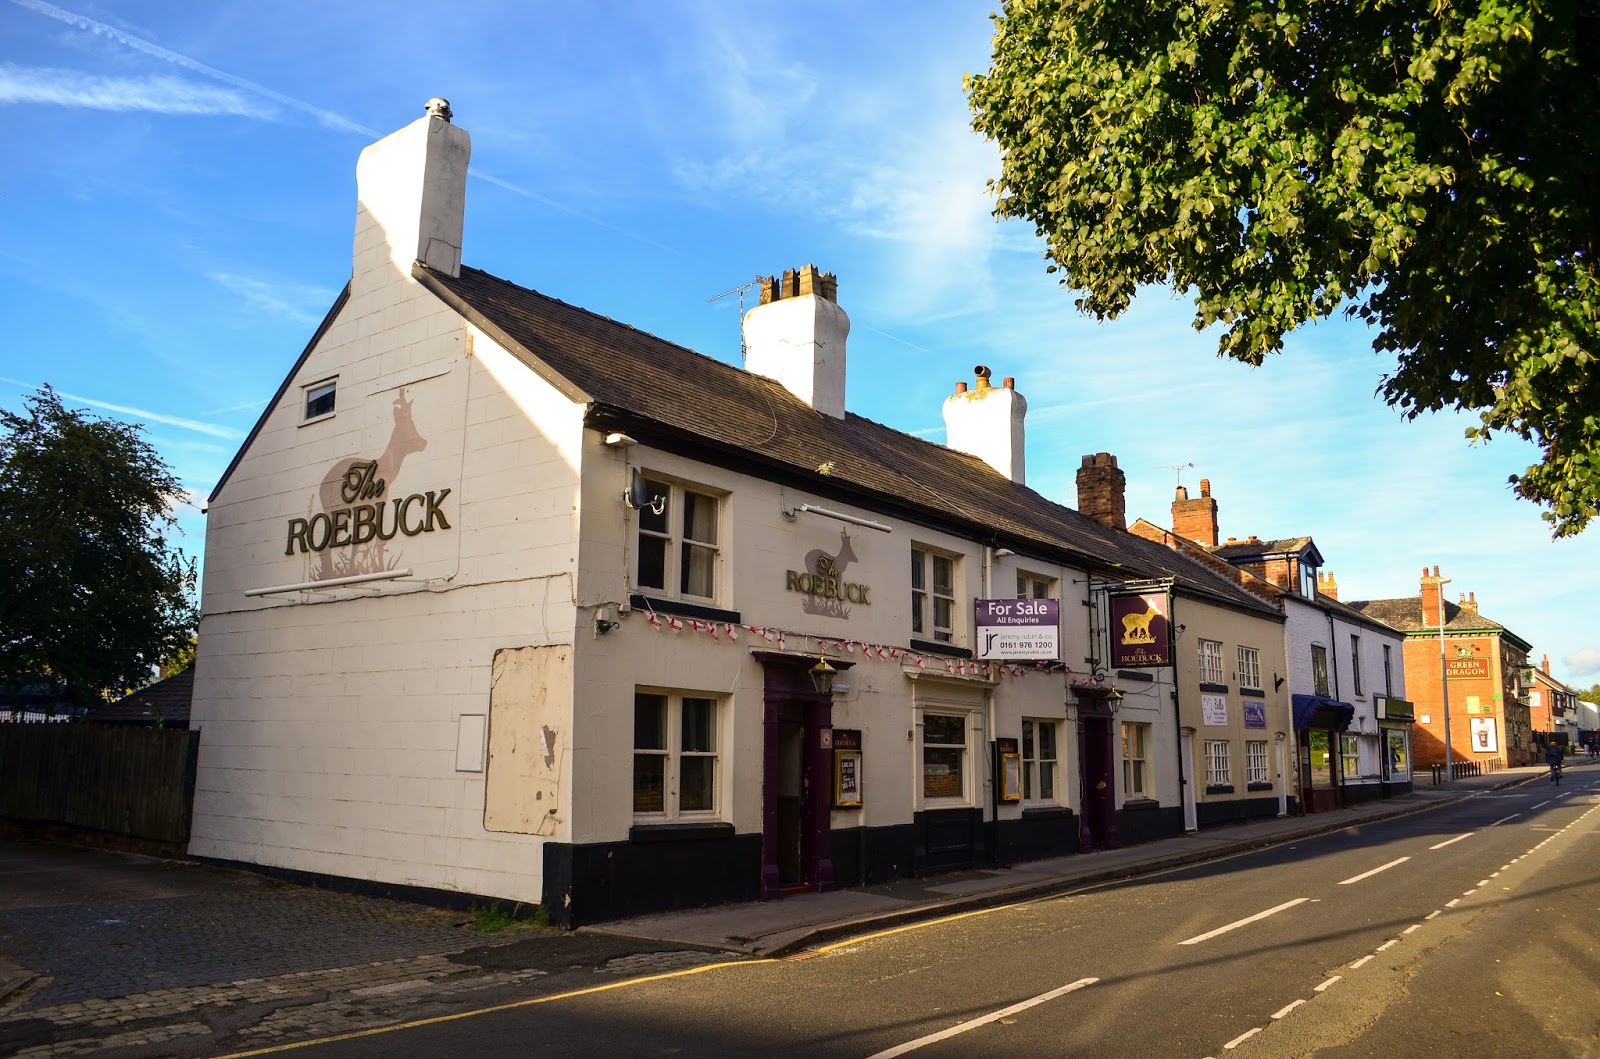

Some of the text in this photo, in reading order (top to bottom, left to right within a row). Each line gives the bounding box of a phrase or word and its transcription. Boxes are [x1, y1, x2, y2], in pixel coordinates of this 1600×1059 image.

[341, 459, 385, 503] The
[284, 488, 452, 556] ROEBUCK
[817, 555, 840, 576] The
[786, 569, 871, 605] ROEBUCK
[988, 601, 1048, 615] For Sale
[1007, 616, 1039, 625] Enquiries
[1000, 641, 1053, 649] 0161 976 1200
[1121, 654, 1162, 663] ROEBUCK
